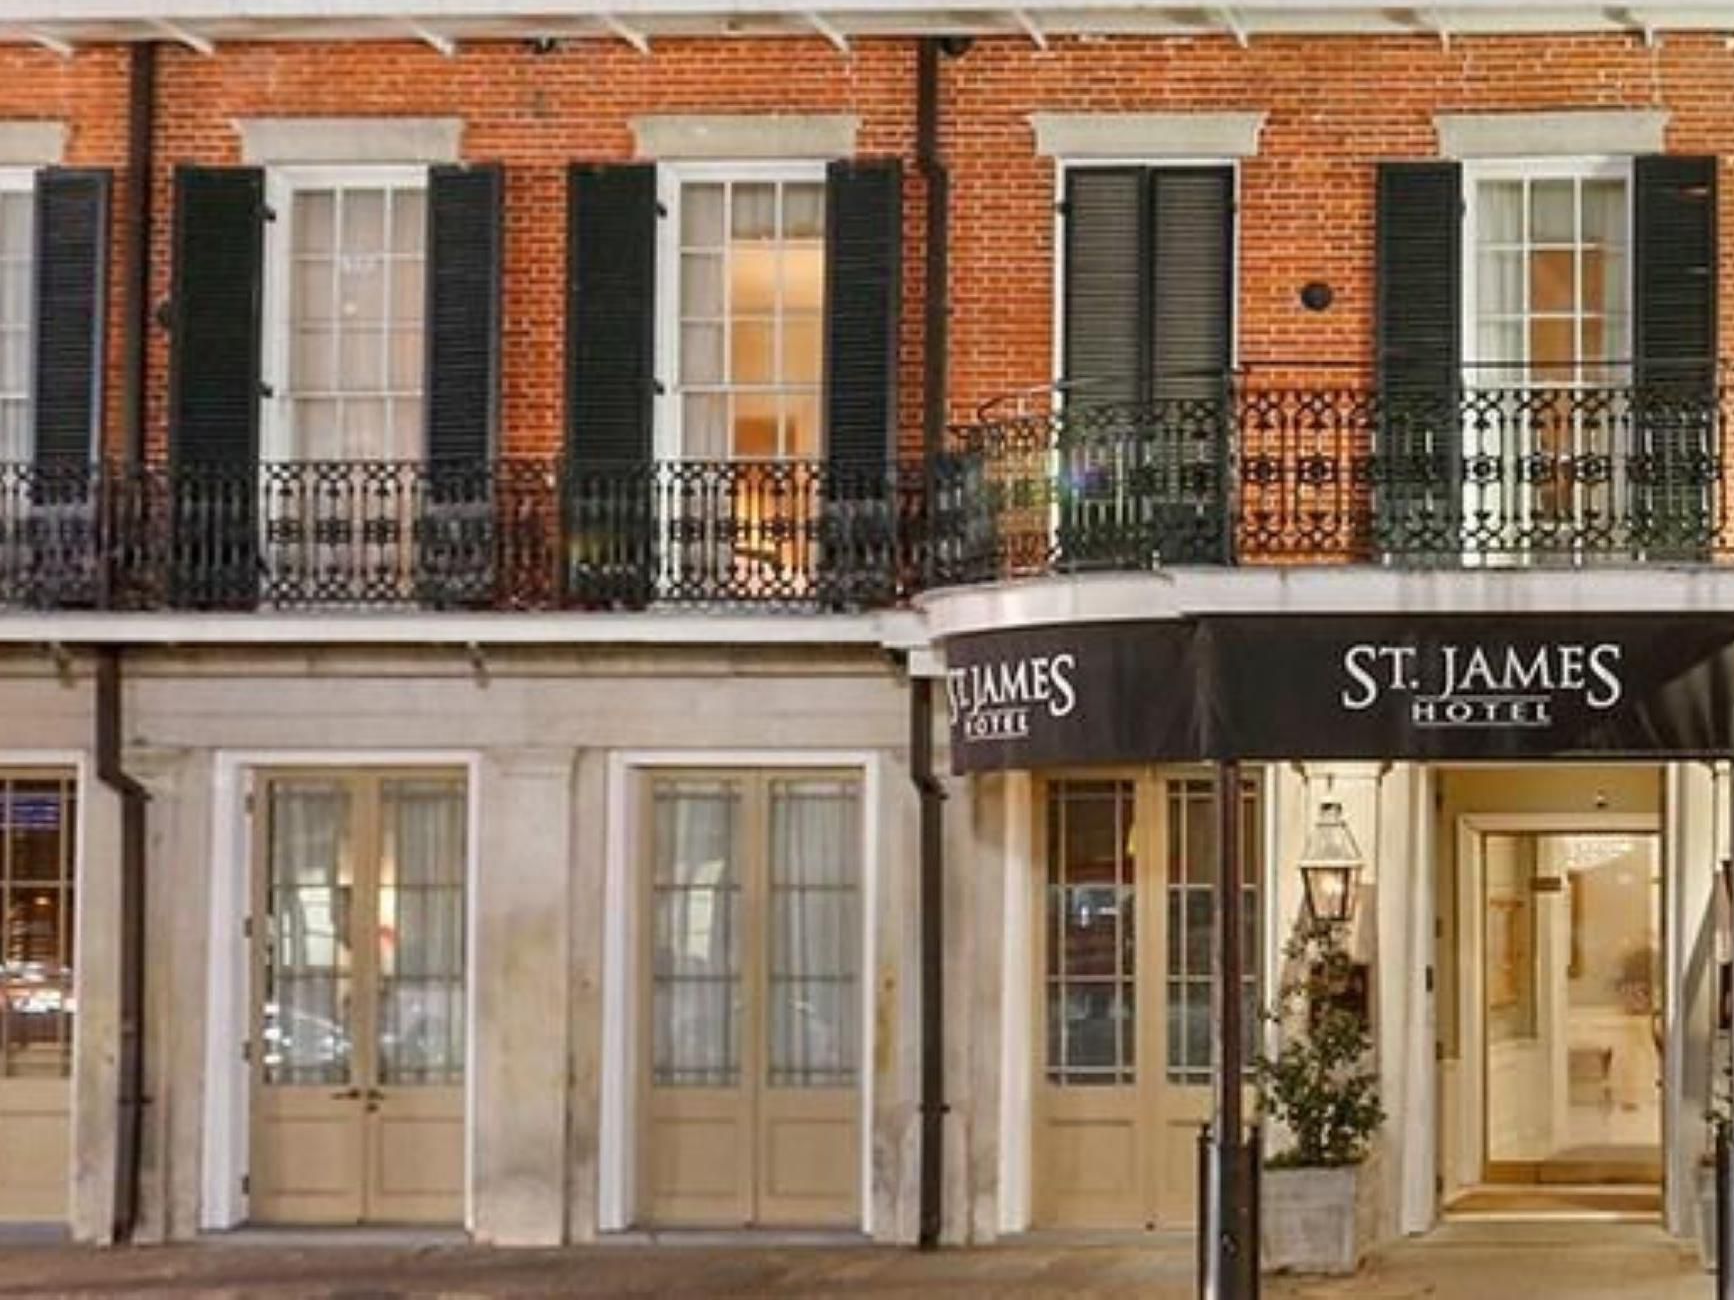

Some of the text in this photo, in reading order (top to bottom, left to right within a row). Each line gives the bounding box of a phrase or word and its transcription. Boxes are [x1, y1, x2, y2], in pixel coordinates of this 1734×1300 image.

[970, 654, 1076, 717] JAMES
[1341, 644, 1622, 709] ST. JAMES
[1411, 703, 1550, 722] HOTEL
